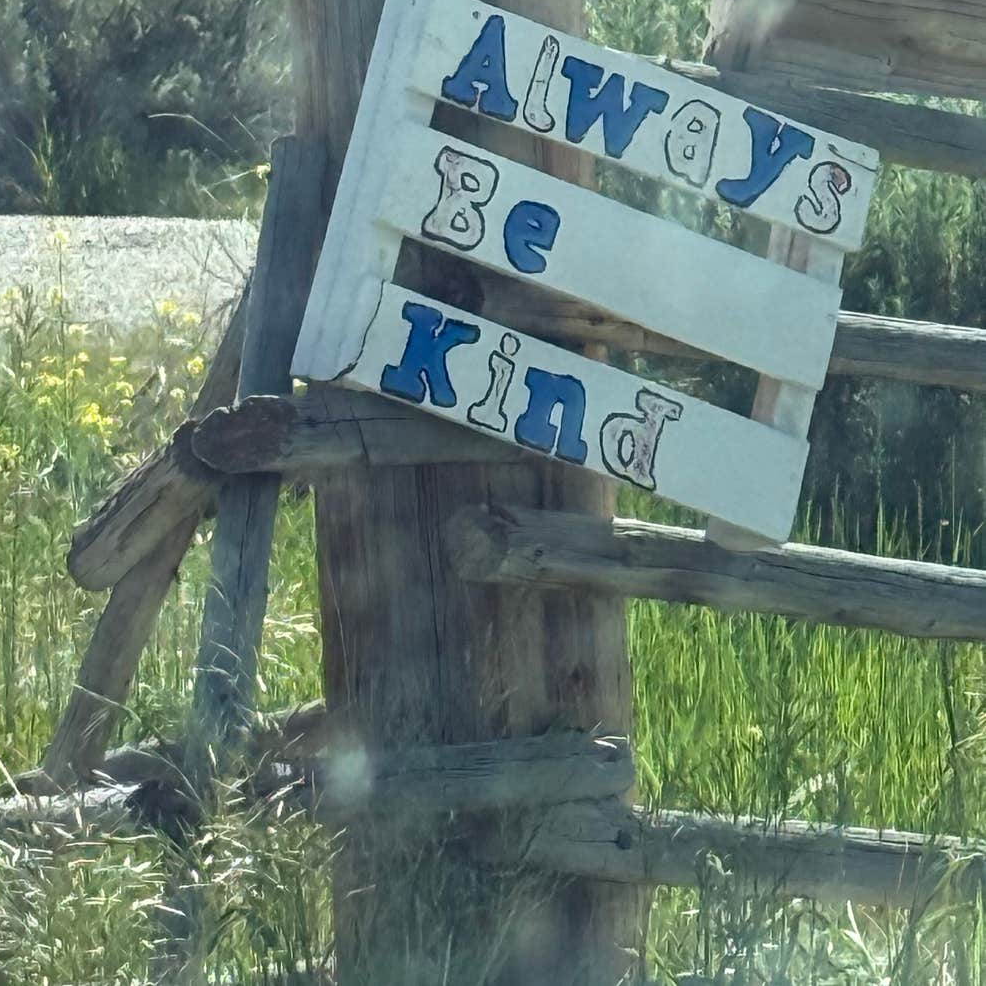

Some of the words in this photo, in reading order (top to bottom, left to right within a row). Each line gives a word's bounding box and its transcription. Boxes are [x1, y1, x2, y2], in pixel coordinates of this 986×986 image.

[420, 145, 561, 273] Be
[441, 15, 852, 235] Always
[380, 301, 683, 491] Kind
